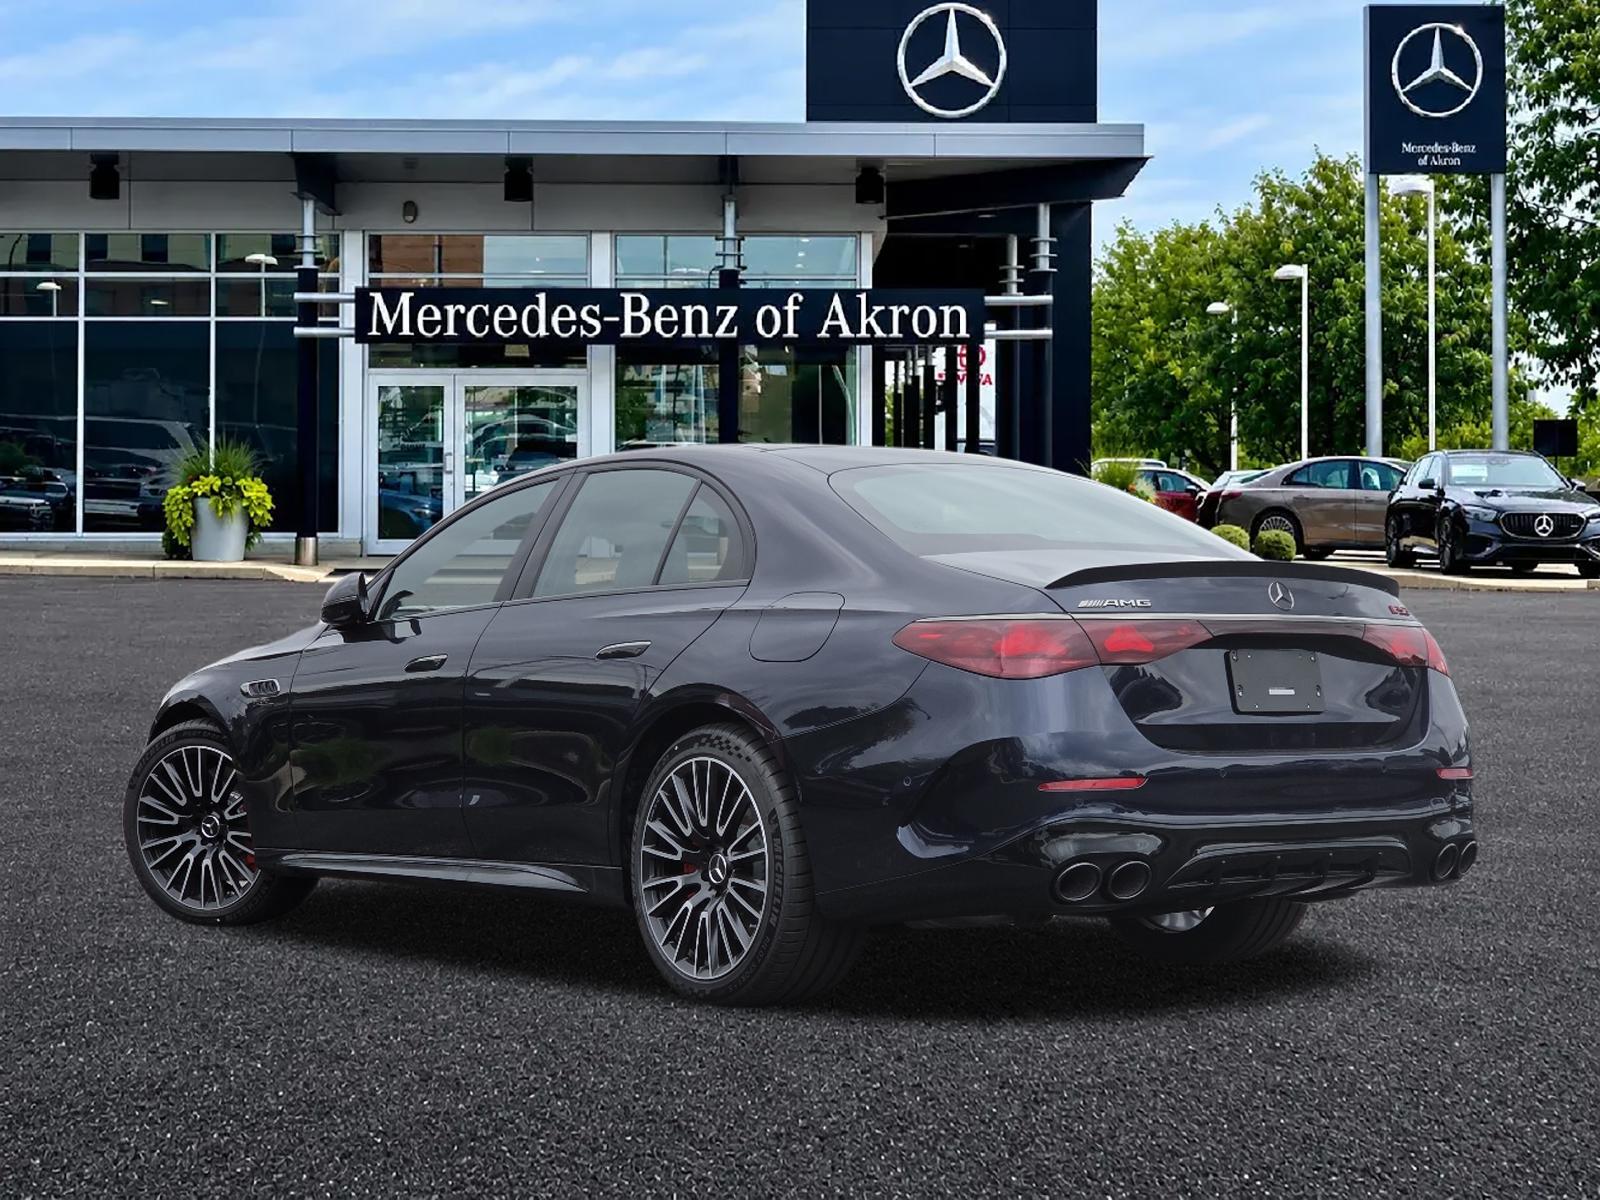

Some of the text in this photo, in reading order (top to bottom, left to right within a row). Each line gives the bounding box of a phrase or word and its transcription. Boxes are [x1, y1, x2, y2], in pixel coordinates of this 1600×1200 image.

[1401, 142, 1477, 154] Mercedes-Benz
[1417, 155, 1461, 166] of Akron
[367, 292, 970, 338] Mercedes-Benz of Akron
[1101, 599, 1152, 608] AMG
[768, 837, 784, 928] MICHELIN
